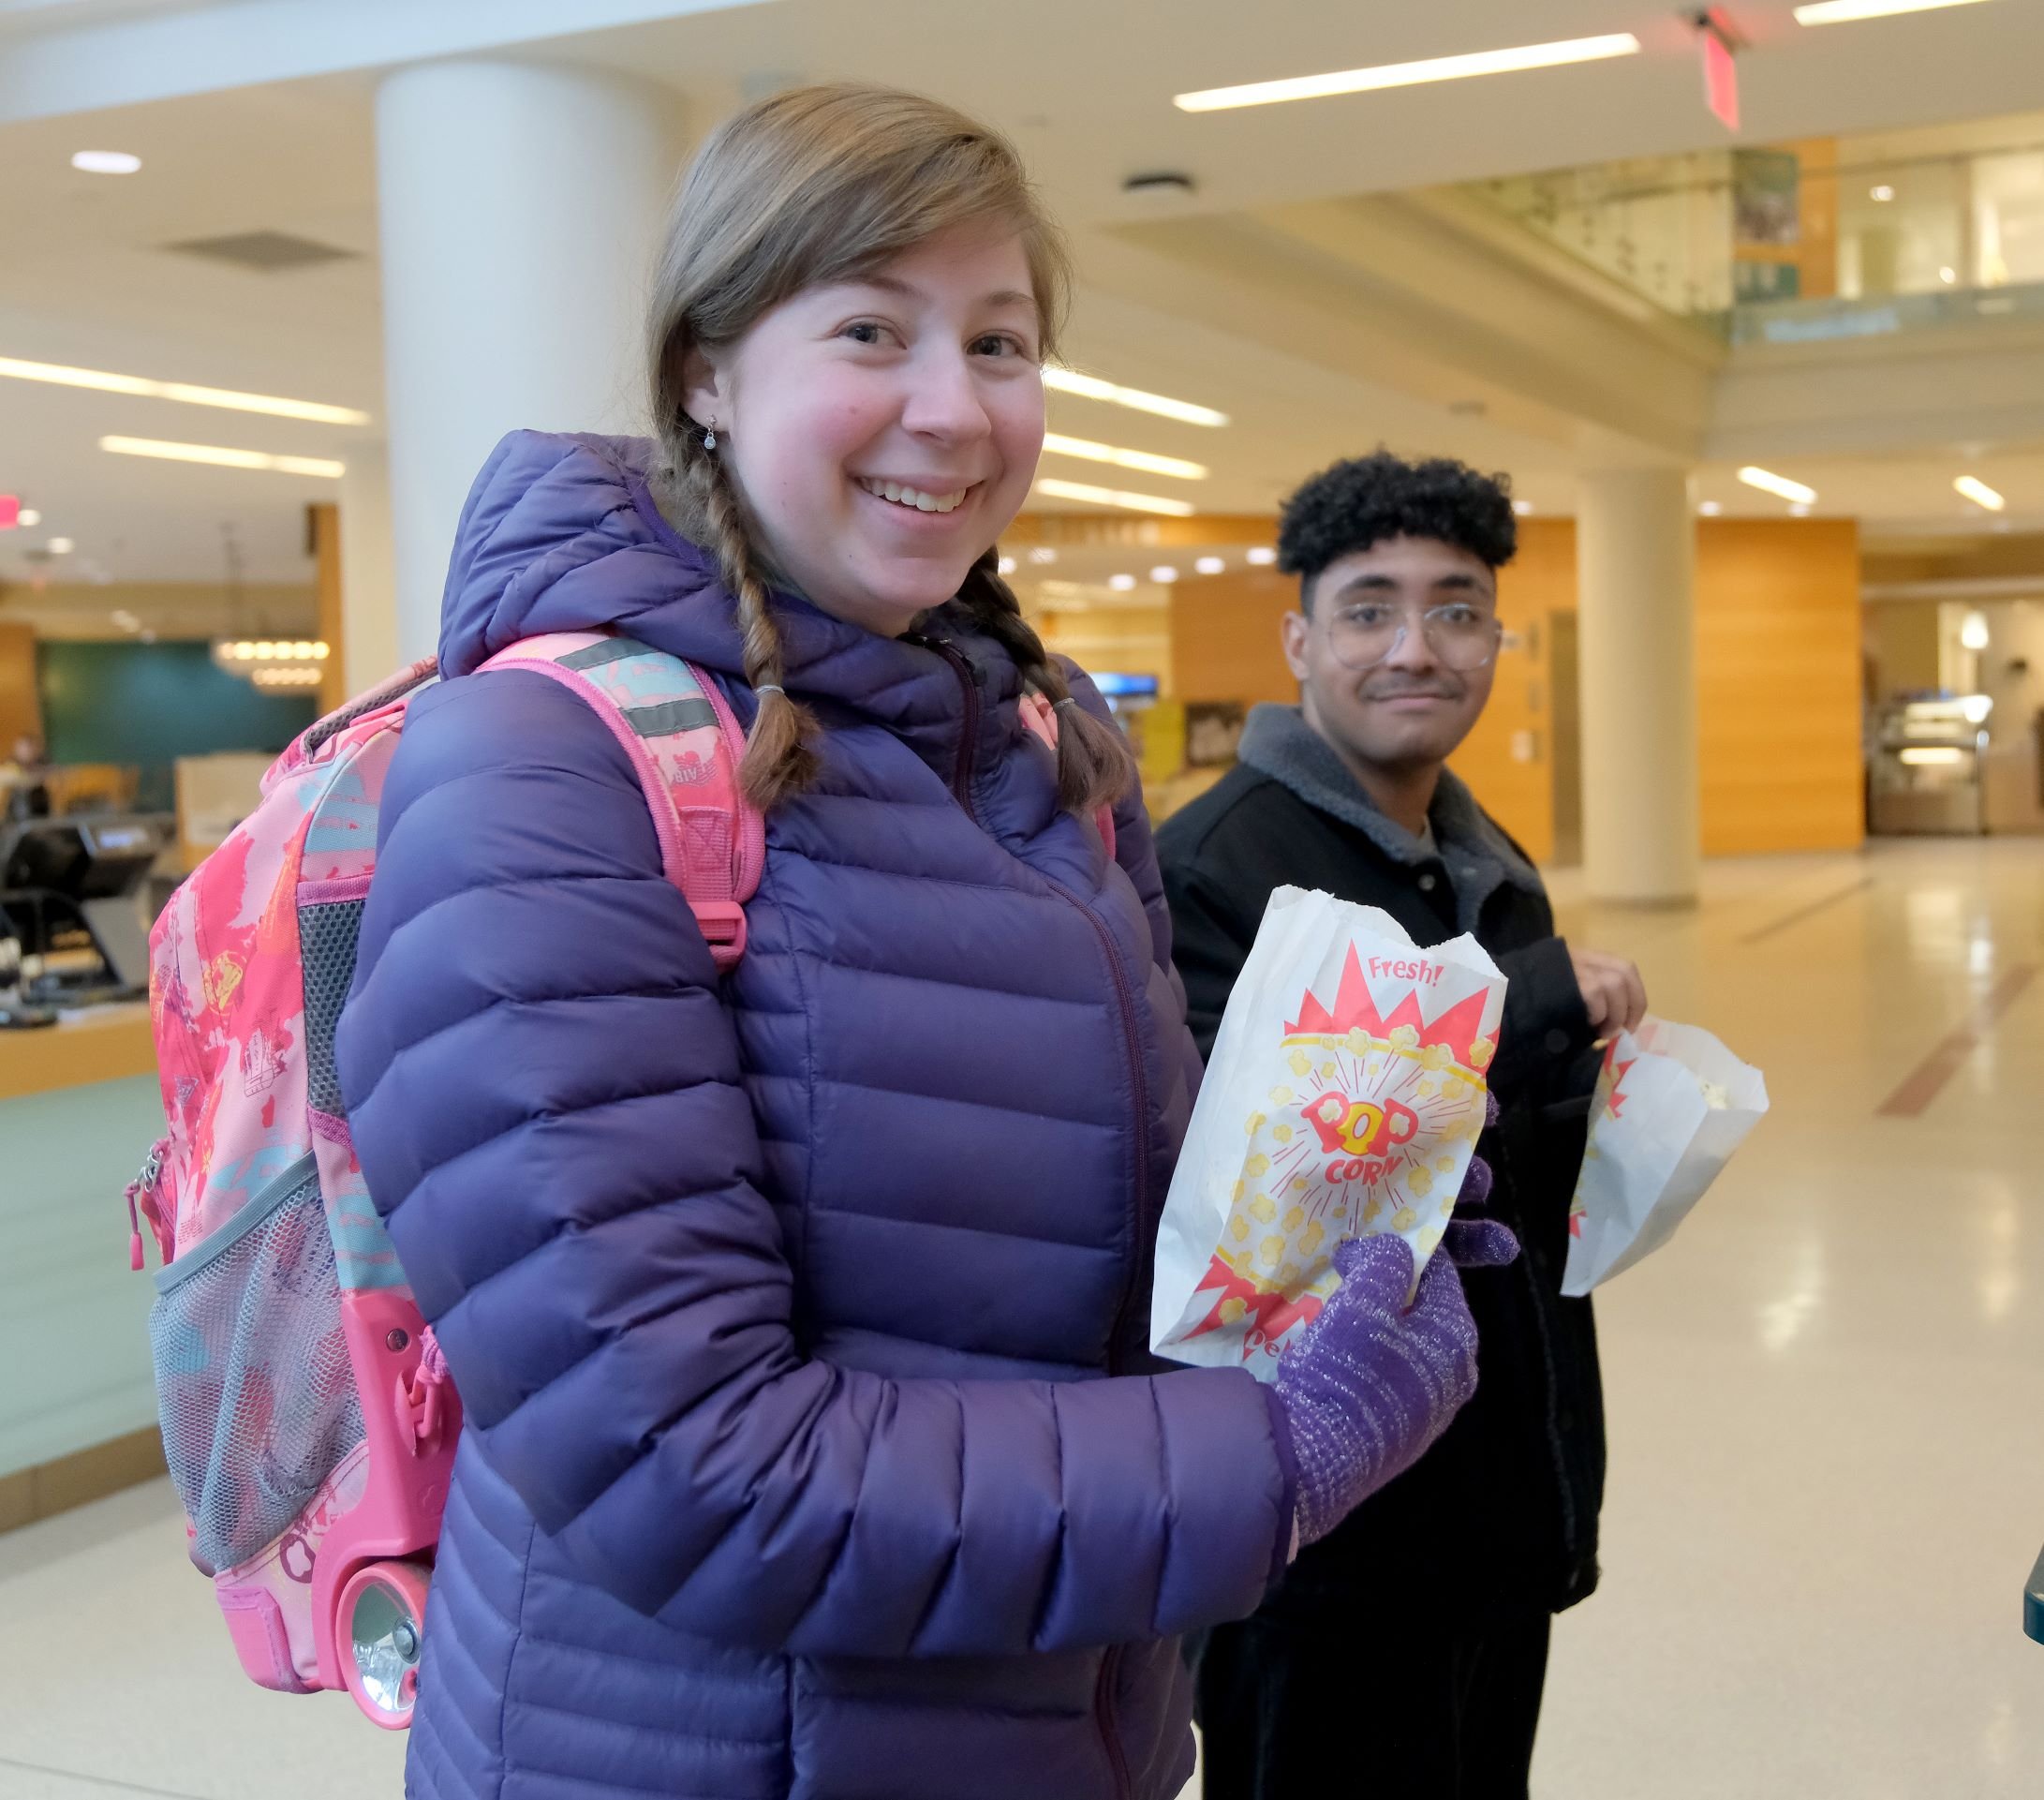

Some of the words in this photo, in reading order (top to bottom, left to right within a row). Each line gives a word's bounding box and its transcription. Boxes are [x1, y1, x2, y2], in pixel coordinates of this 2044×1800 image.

[1368, 957, 1444, 988] Fresh!
[1300, 1091, 1418, 1157] POP
[1325, 1155, 1404, 1186] CORN
